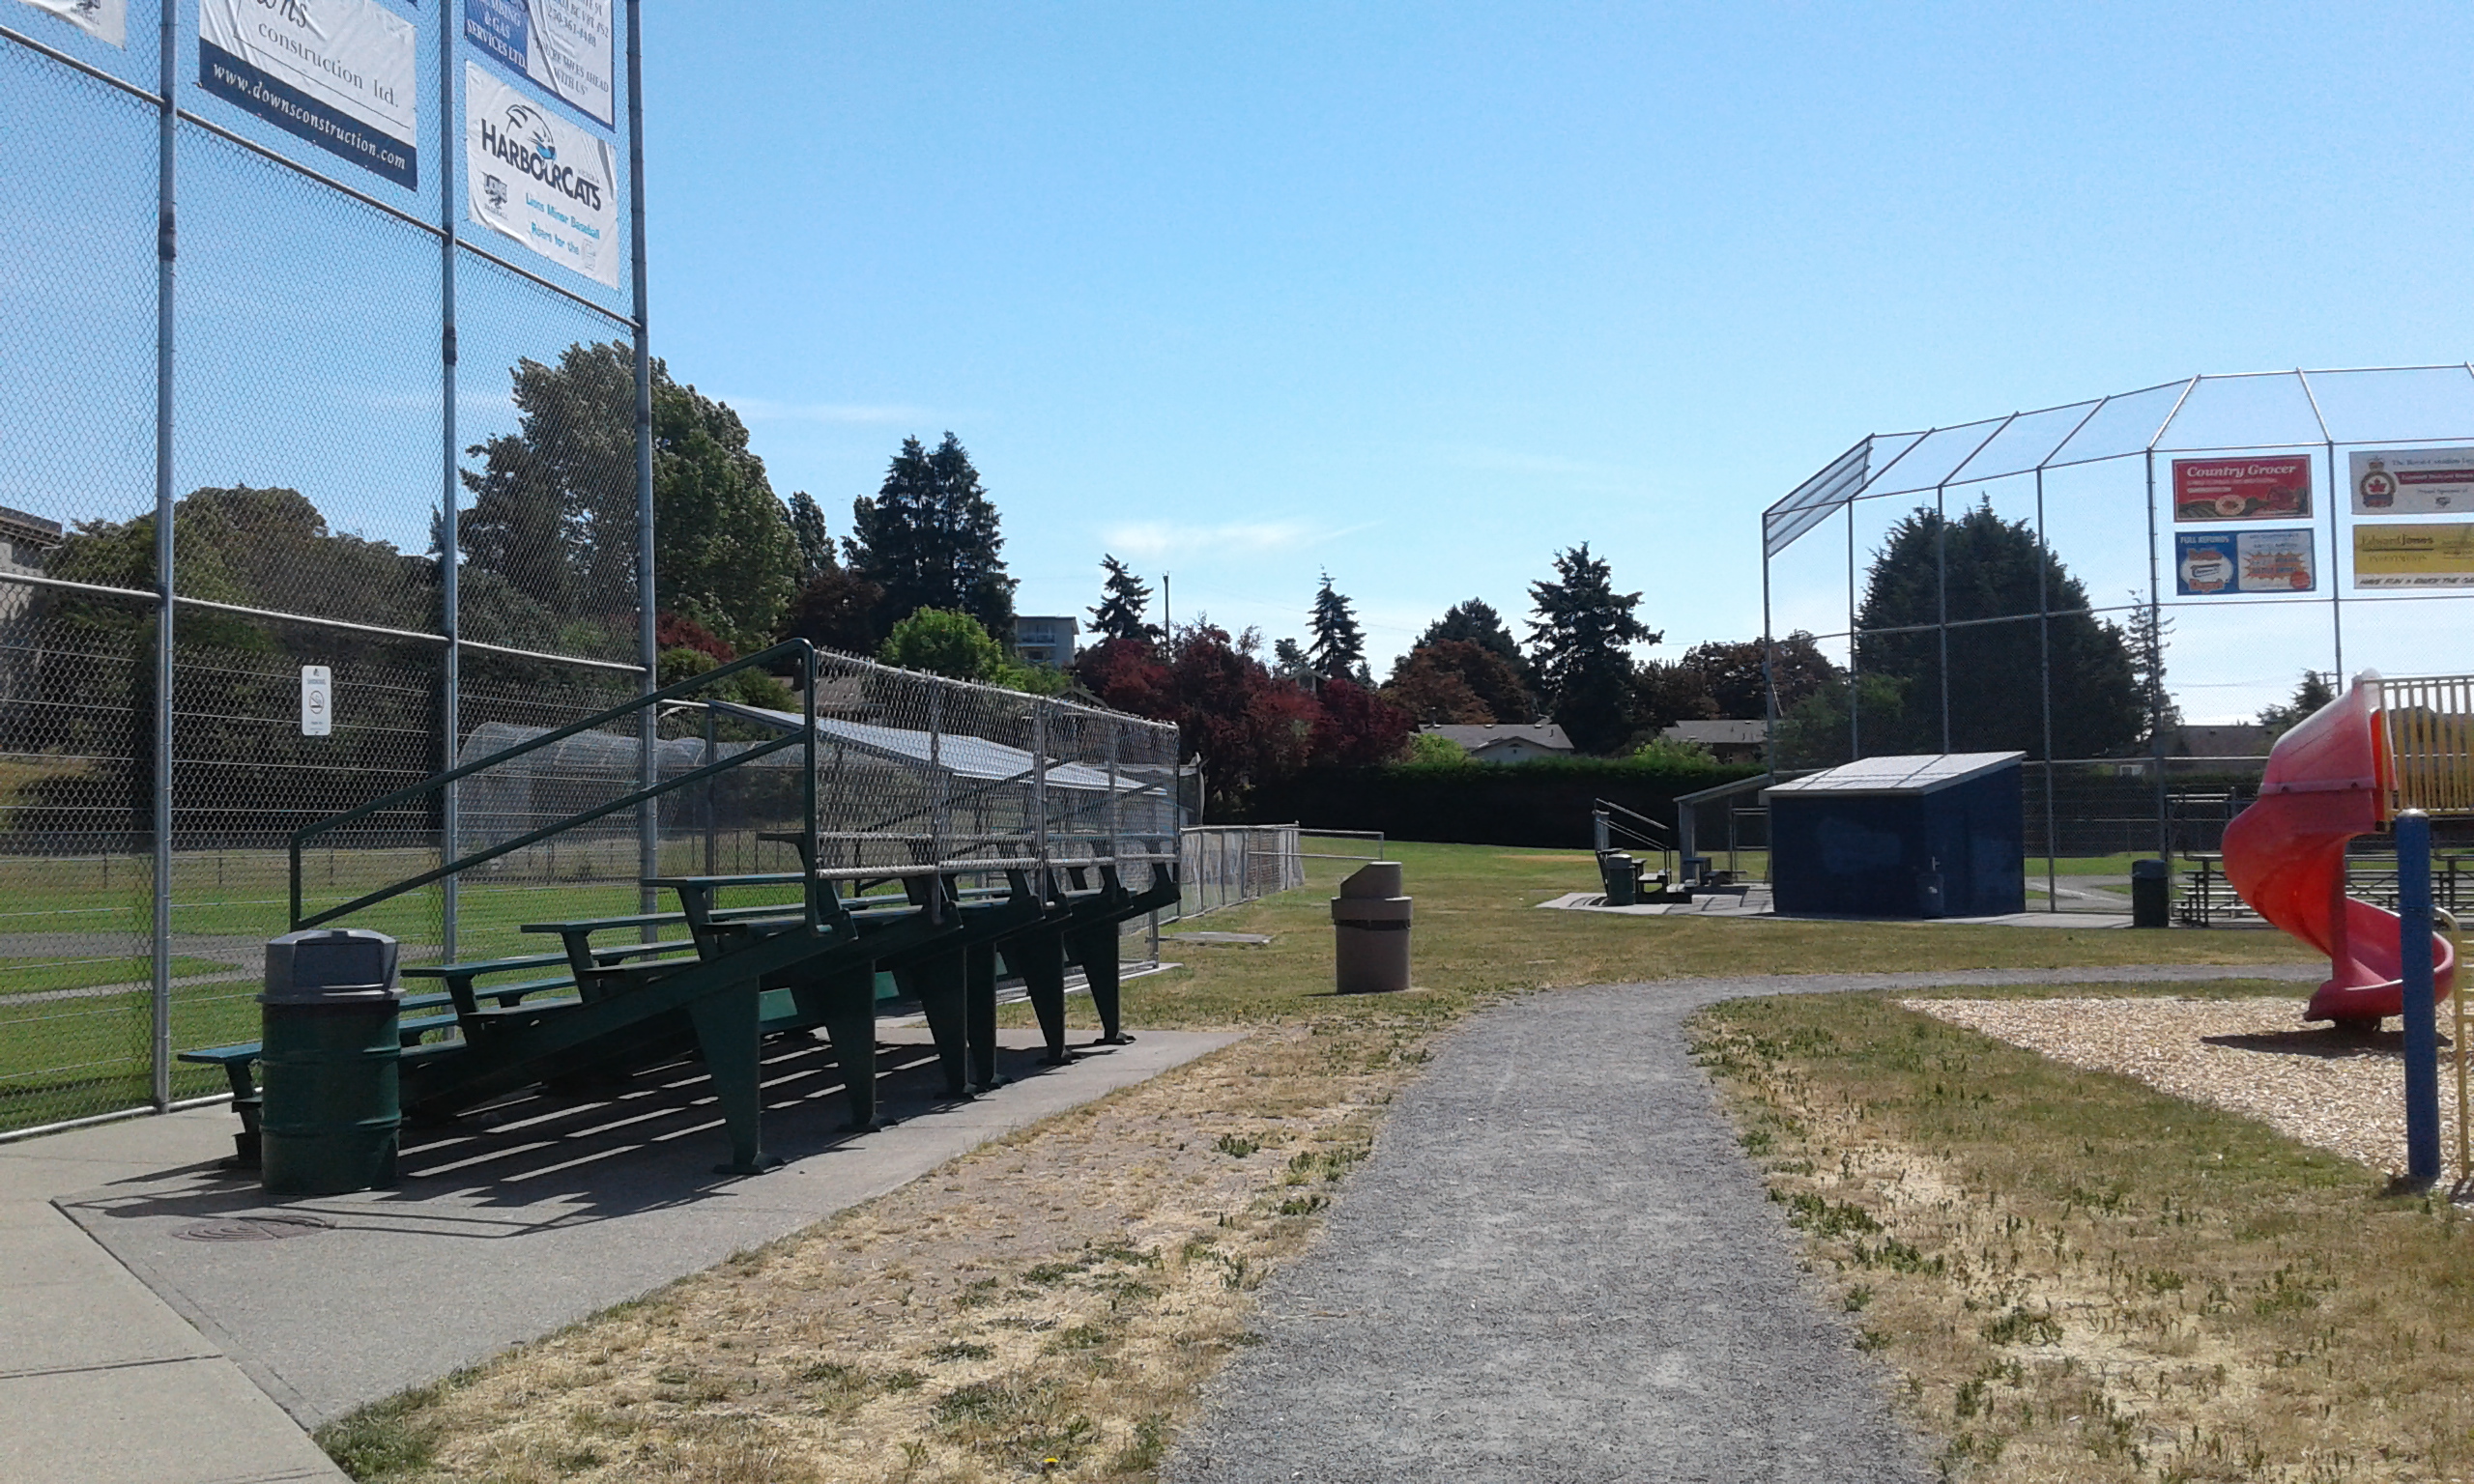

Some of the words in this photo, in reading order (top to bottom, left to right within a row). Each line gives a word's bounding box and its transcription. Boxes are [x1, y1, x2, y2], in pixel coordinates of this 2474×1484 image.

[467, 18, 507, 57] SERVICES
[508, 45, 527, 71] LTD.
[484, 11, 492, 26] &
[493, 16, 510, 40] GAS
[258, 22, 363, 90] construction
[373, 79, 399, 108] ltd.
[586, 71, 609, 93] AHEAD
[213, 63, 406, 171] www.downsconstruction.com
[2187, 467, 2244, 477] Country
[2248, 464, 2296, 475] Grocer
